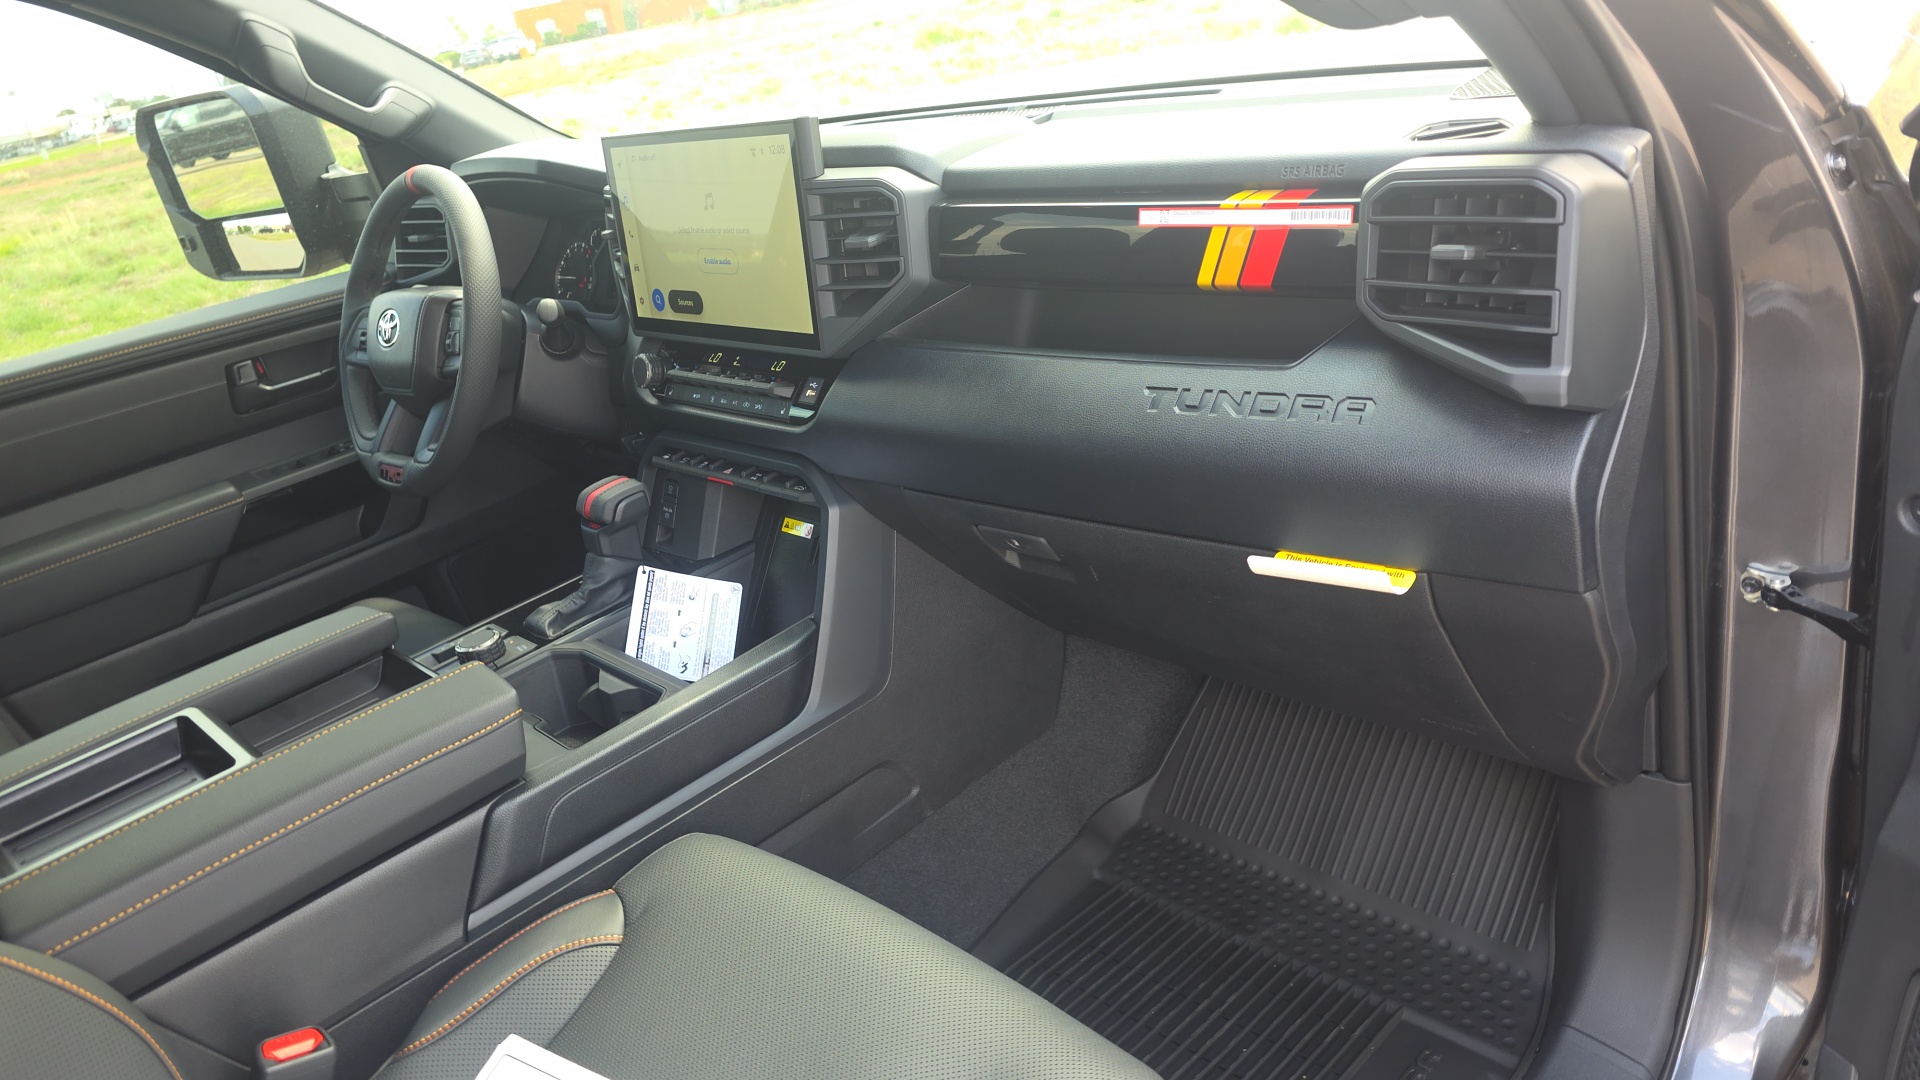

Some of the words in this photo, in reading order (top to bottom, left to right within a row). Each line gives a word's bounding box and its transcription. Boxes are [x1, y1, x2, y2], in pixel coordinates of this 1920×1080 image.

[1281, 166, 1300, 179] SRS
[1301, 163, 1346, 178] AIRBAG
[704, 257, 718, 265] Enable
[678, 298, 694, 307] Sources
[1144, 386, 1377, 425] TUNDRA
